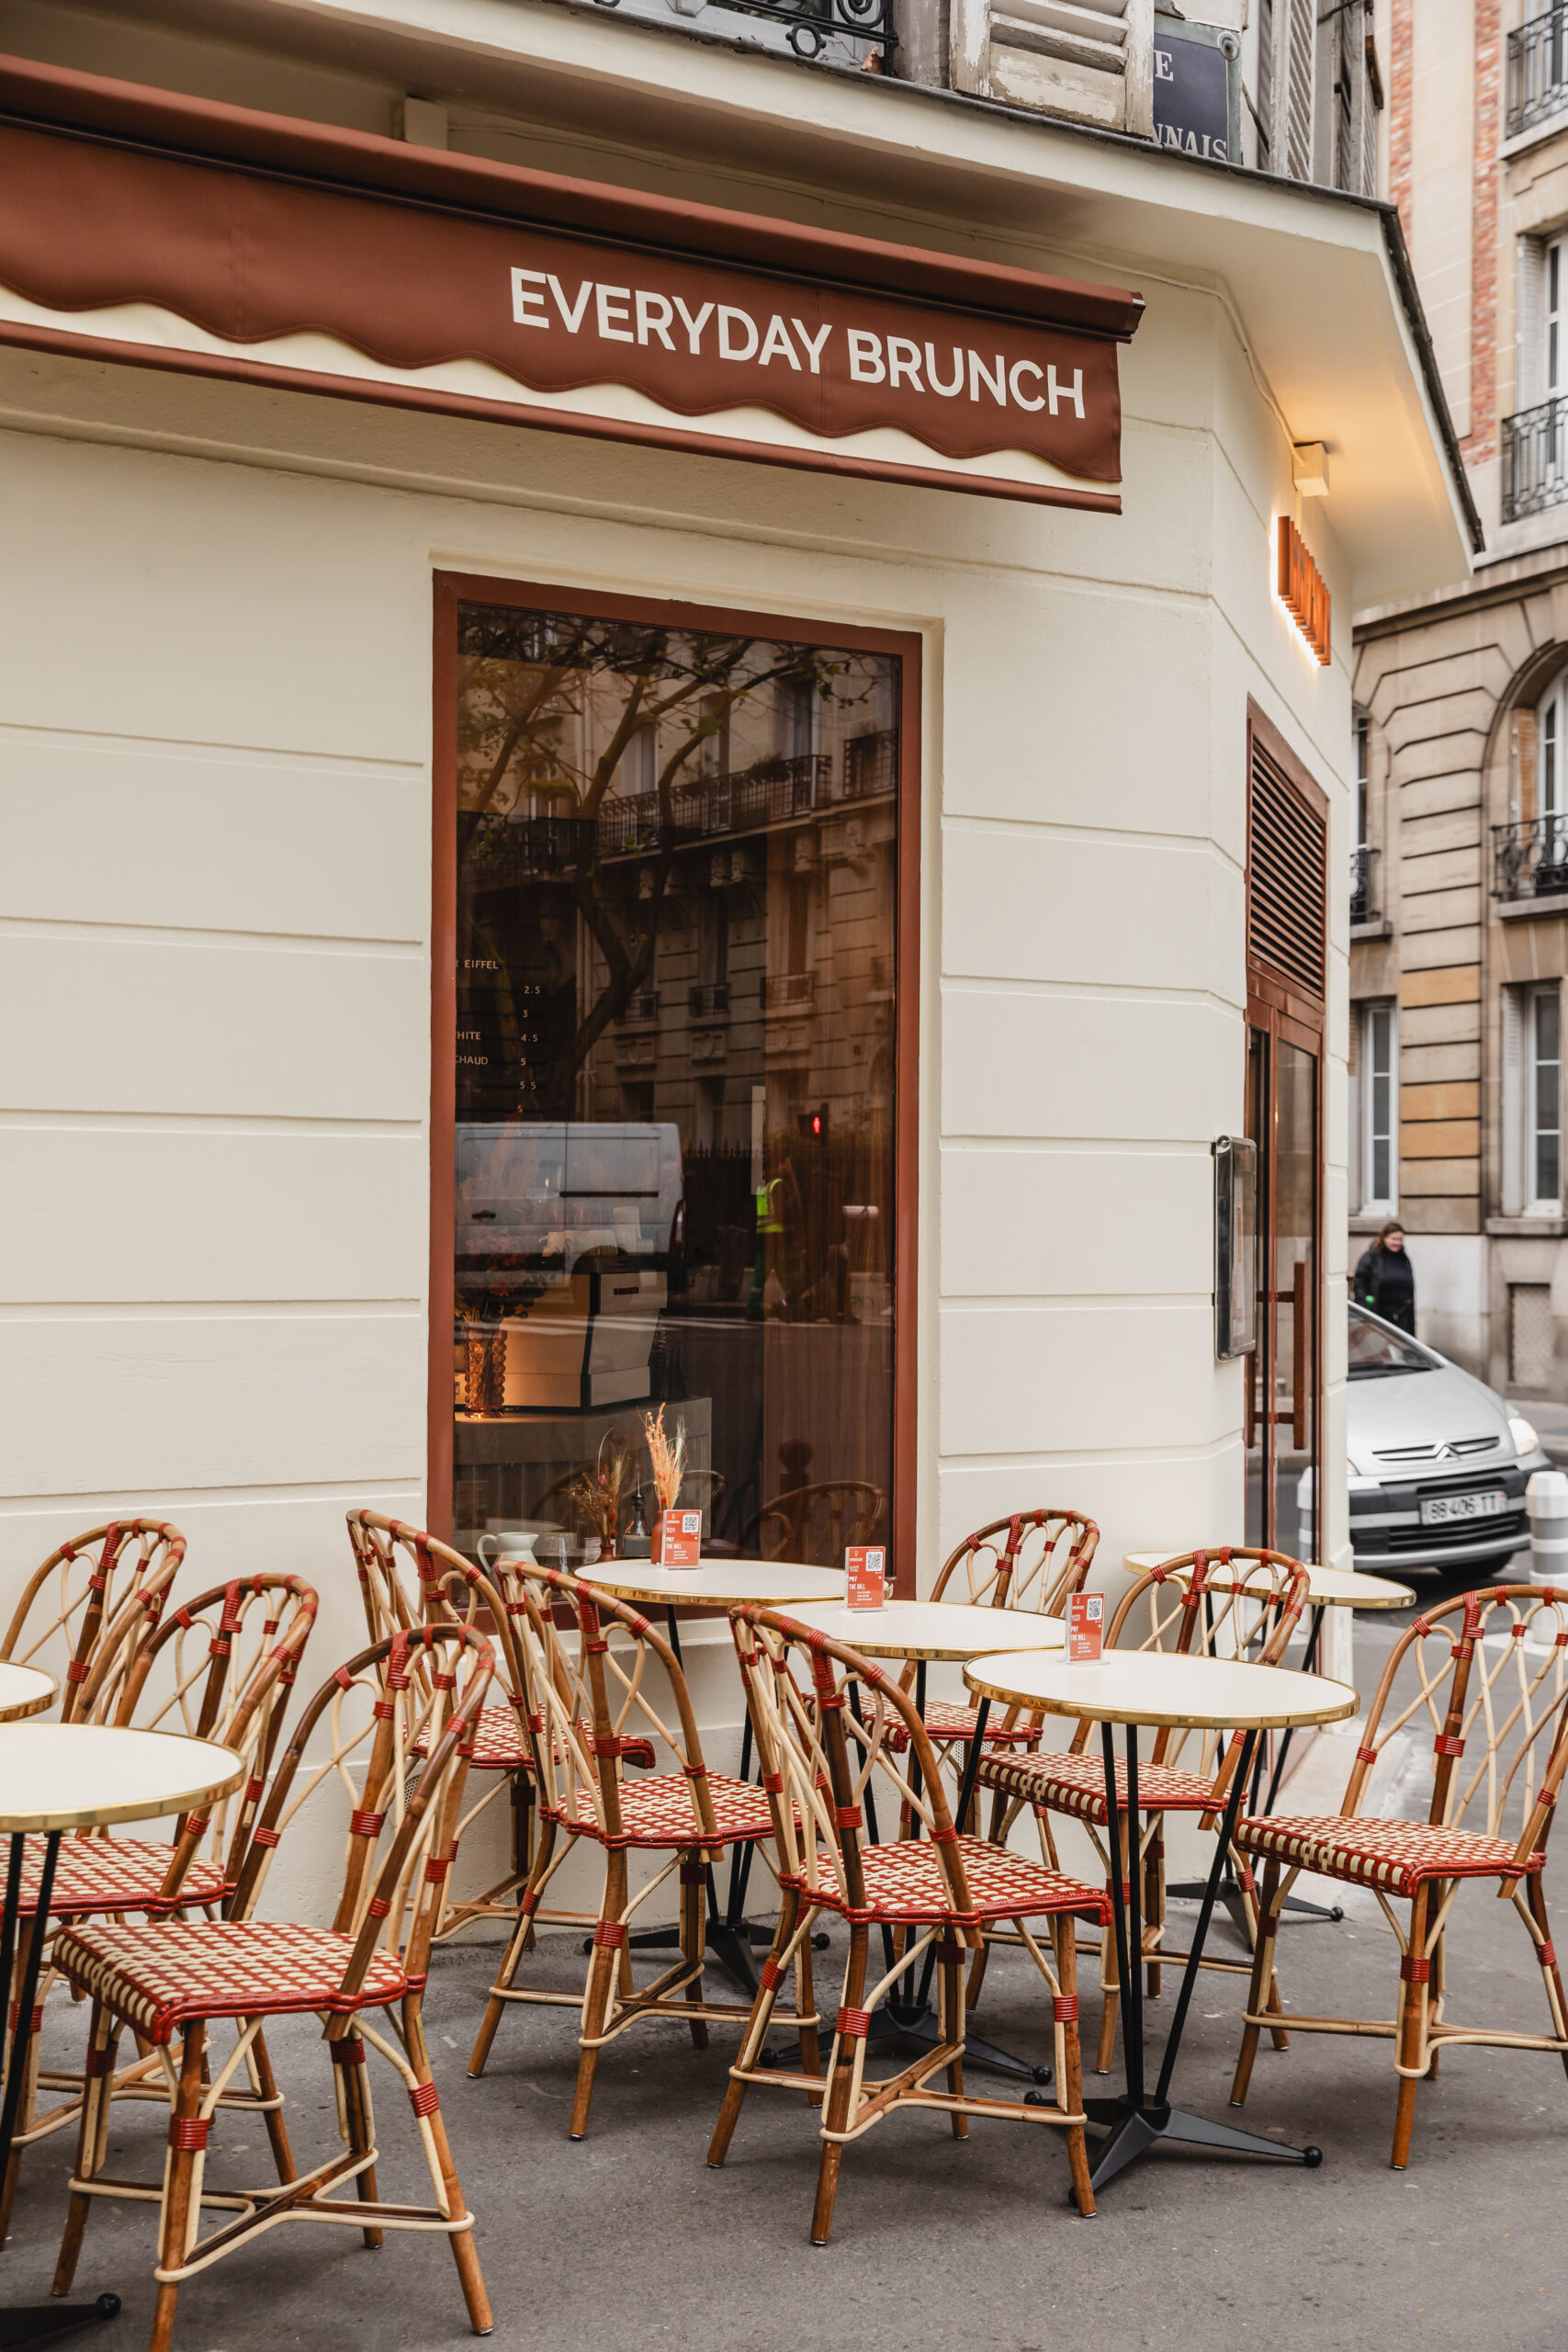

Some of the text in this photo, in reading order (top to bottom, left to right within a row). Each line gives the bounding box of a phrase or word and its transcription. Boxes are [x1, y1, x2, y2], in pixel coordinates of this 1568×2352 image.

[1154, 50, 1174, 81] E
[1153, 123, 1227, 162] NNAIS
[510, 266, 1086, 419] EVERYDAY BRUNCH
[464, 959, 499, 969] EIFFEL
[524, 986, 540, 994] 2.5
[522, 1010, 528, 1018] 3
[456, 1031, 538, 1043] HITE 4.5
[520, 1057, 526, 1067] 5
[519, 1081, 536, 1090] 5.5
